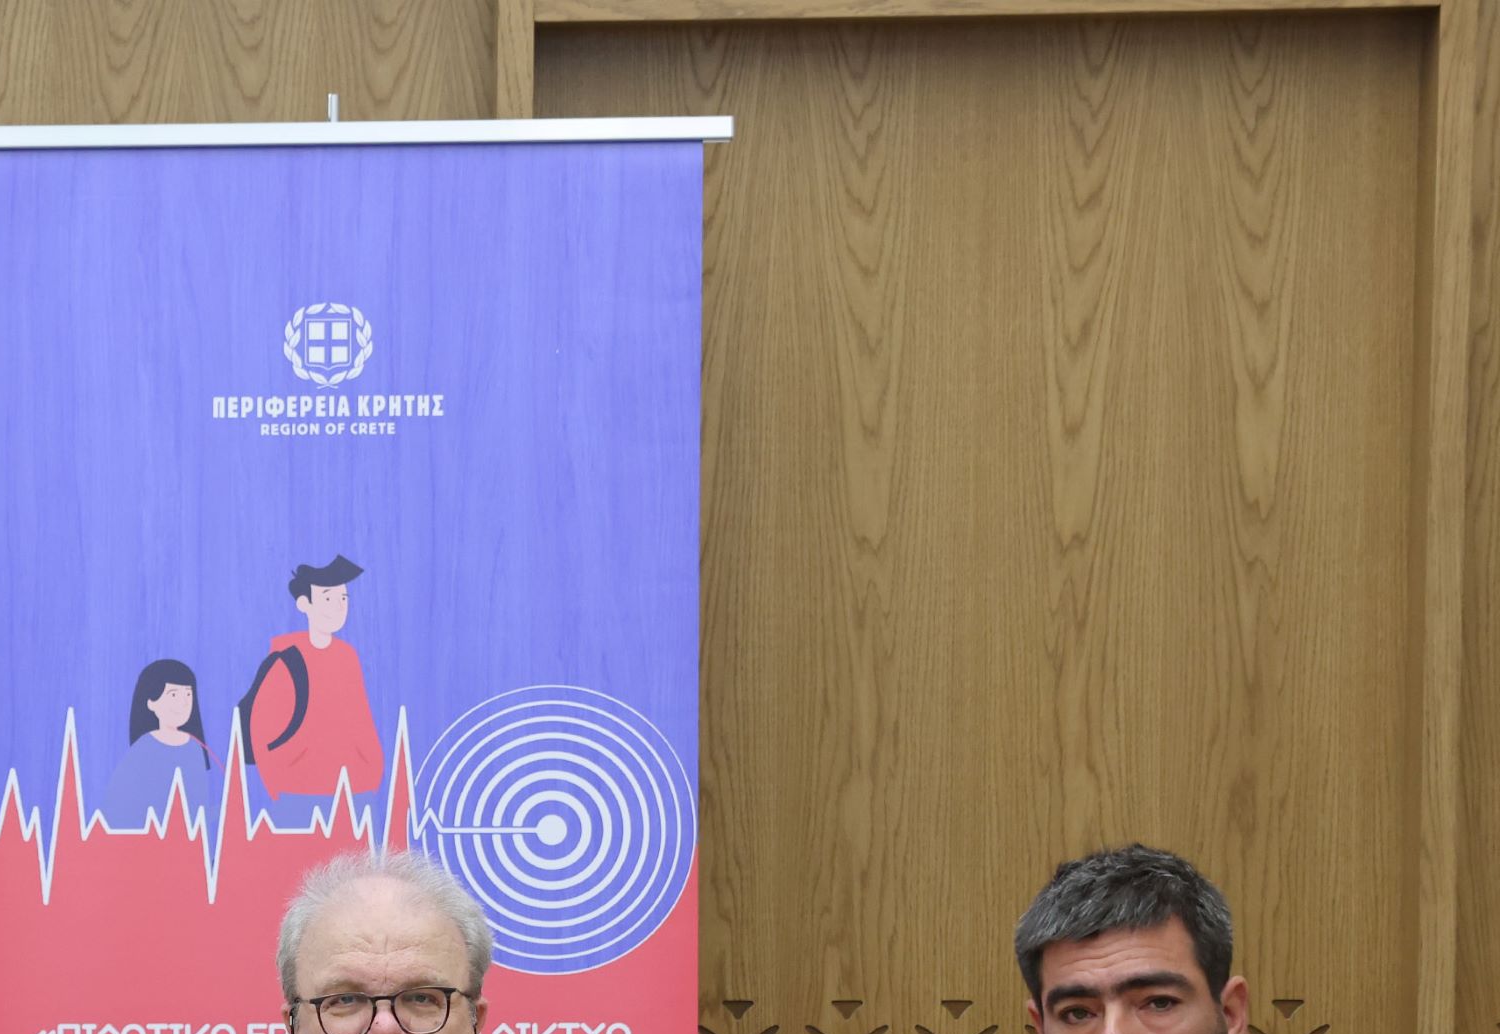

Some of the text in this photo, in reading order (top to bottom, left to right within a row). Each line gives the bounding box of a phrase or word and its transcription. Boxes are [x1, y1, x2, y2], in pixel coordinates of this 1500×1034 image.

[212, 394, 444, 419] ΠΕΡΙΦΕΡΕΙΑ ΚΡΗΤΗΣ
[260, 422, 396, 436] REGION OF CRETE
